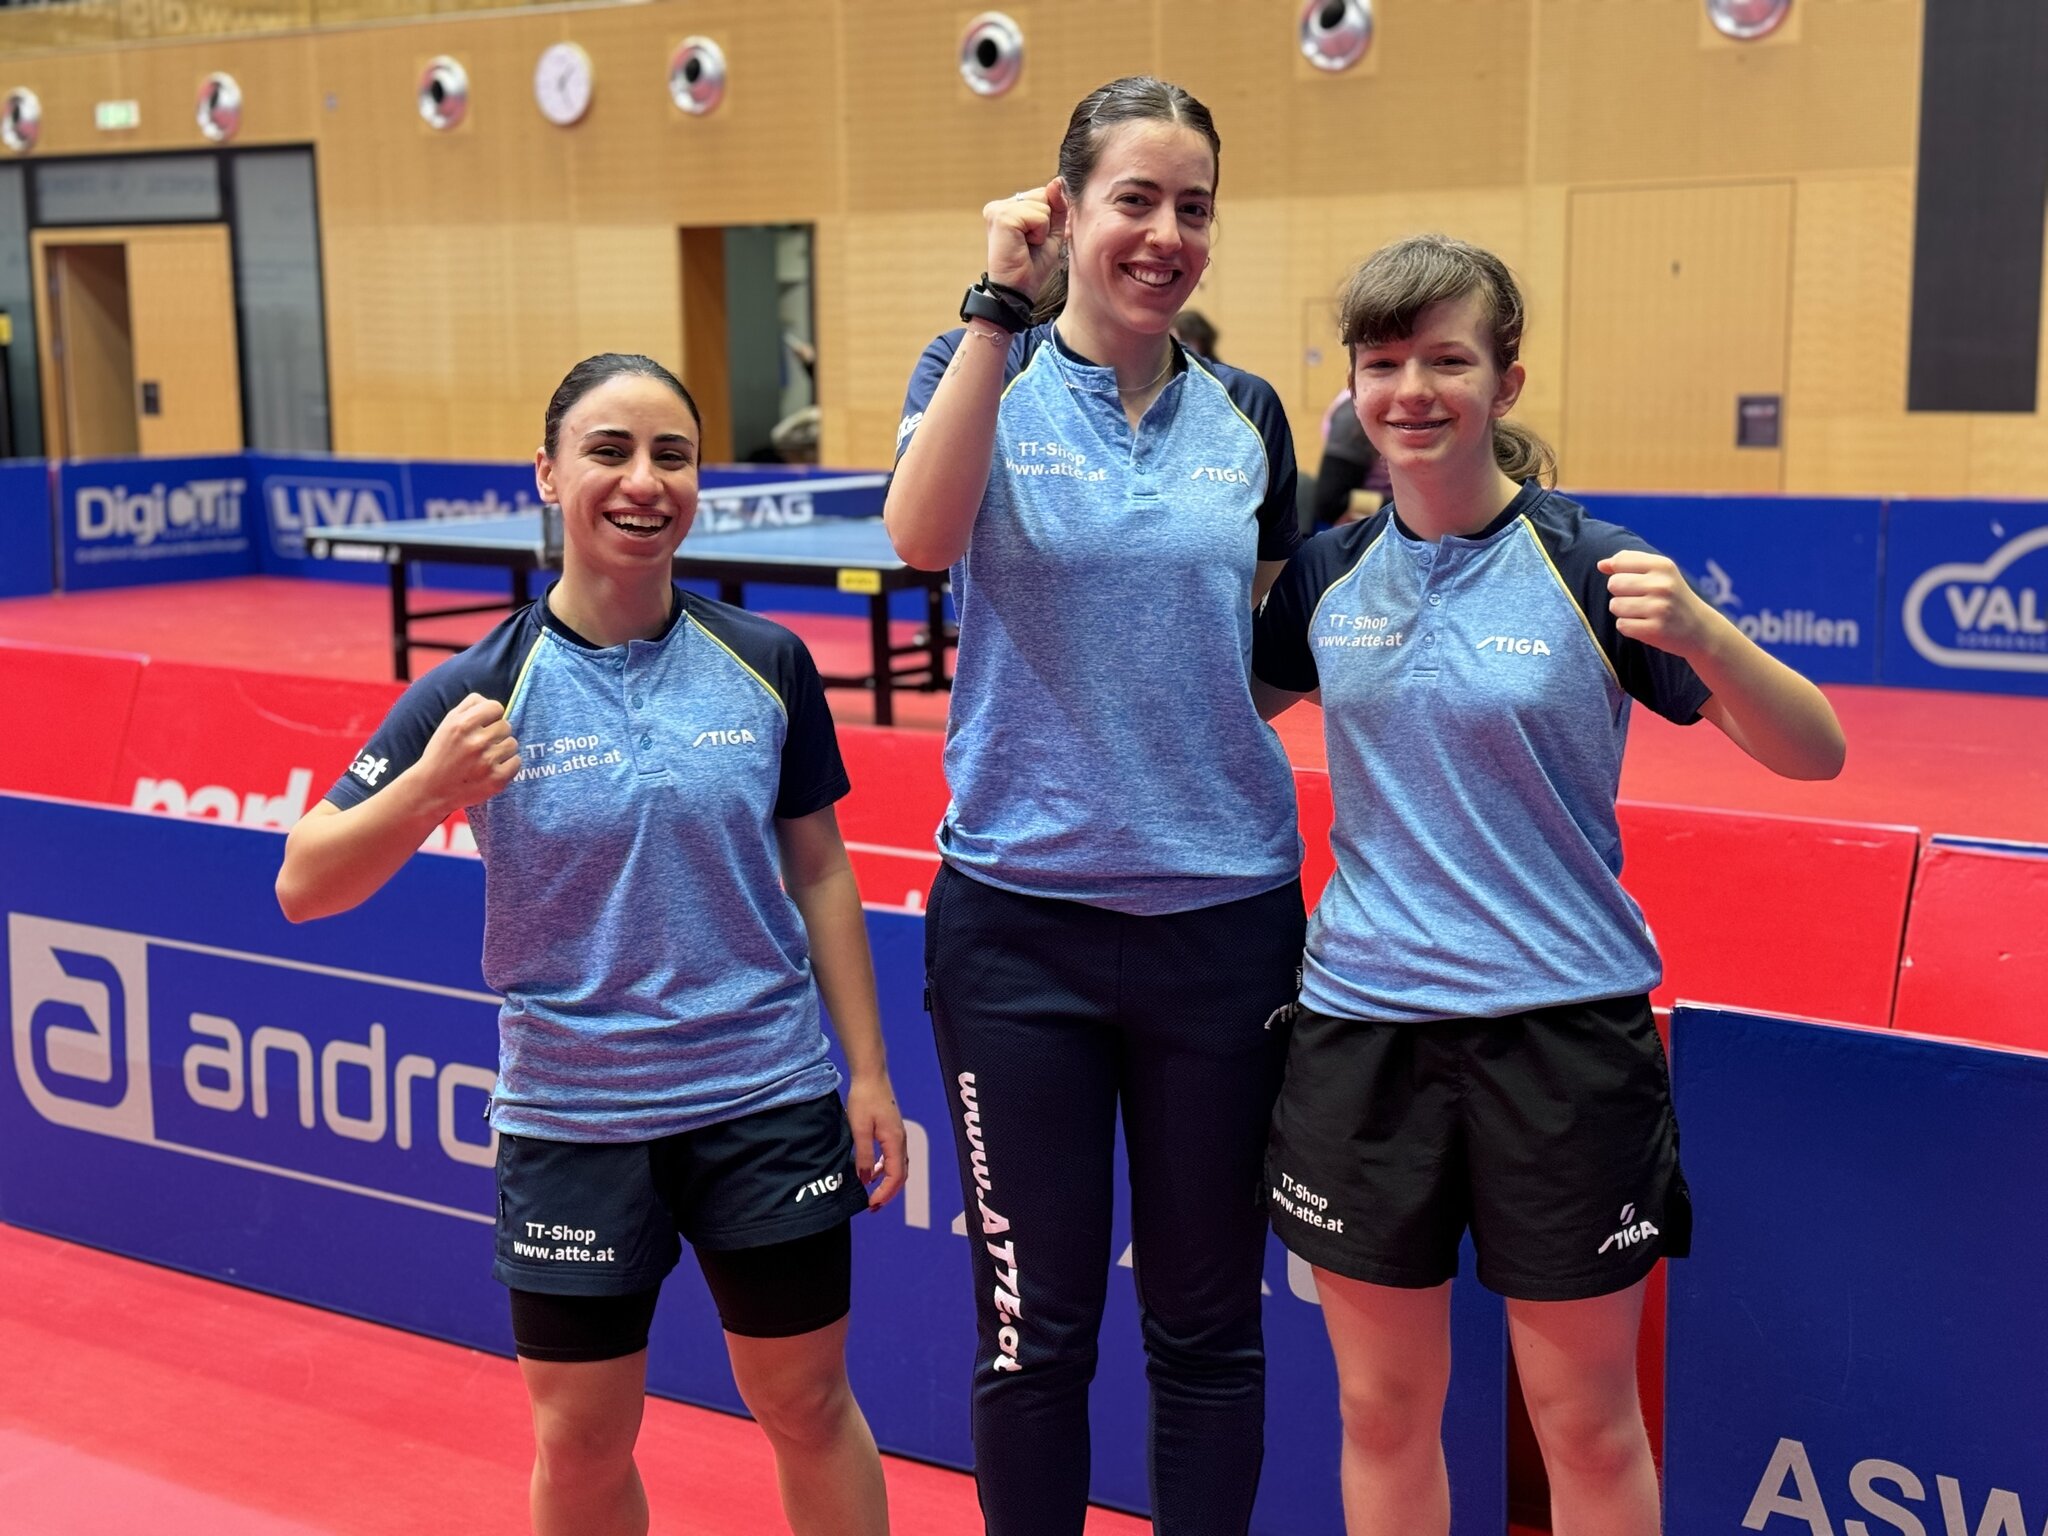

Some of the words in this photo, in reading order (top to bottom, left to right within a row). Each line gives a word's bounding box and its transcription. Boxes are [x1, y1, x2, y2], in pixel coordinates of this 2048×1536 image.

[1018, 441, 1087, 467] TT-Shop
[1190, 466, 1250, 487] STIGA
[269, 486, 388, 530] LIVA
[750, 492, 815, 529] AG
[1328, 612, 1389, 632] TT-Shop
[1944, 584, 2048, 634] VAL
[1317, 631, 1404, 649] www.atte.at
[1735, 607, 1861, 649] obilien
[1476, 635, 1551, 657] STIGA
[525, 734, 600, 760] TT-Shop
[692, 729, 756, 748] STIGA
[512, 748, 622, 783] www.atte.at
[183, 1011, 500, 1169] andro
[1280, 1172, 1328, 1212] TT-Shop
[1271, 1186, 1344, 1234] www.atte.at
[524, 1221, 597, 1244] TT-Shop
[1597, 1219, 1659, 1255] STIGA
[512, 1240, 616, 1263] www.atte.at
